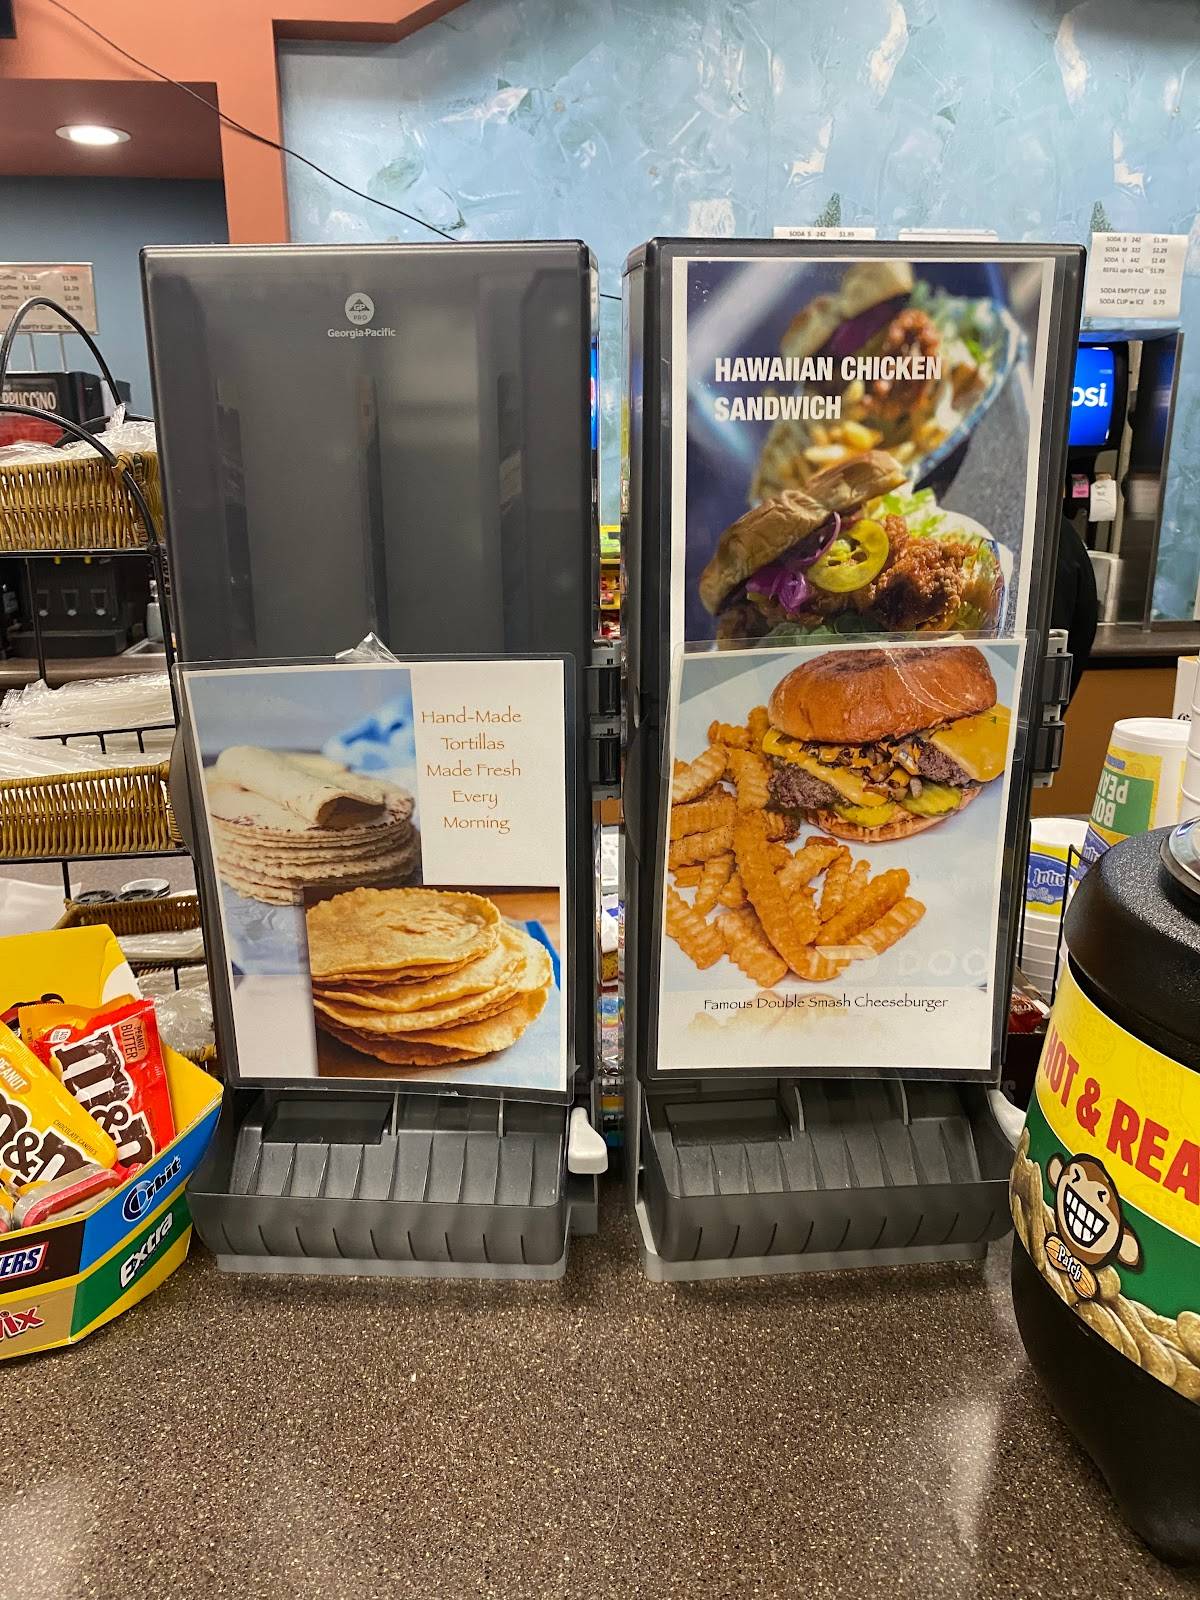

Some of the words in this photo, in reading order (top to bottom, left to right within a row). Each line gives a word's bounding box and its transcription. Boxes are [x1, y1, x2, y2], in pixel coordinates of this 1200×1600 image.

[327, 327, 397, 339] Georgia-Pacific
[714, 356, 833, 382] HAWAIIAN
[841, 355, 942, 381] CHICKEN
[714, 395, 842, 422] SANDWICH
[421, 705, 522, 724] Hand-Made
[440, 732, 505, 751] Tortillas
[427, 759, 473, 777] Made
[477, 759, 521, 777] Fresh
[452, 790, 498, 809] Every
[1097, 770, 1130, 805] PEA
[1091, 793, 1116, 828] BOI
[443, 815, 511, 834] Morning
[703, 999, 753, 1011] Famous
[756, 994, 805, 1010] Double
[808, 993, 851, 1009] Smash
[855, 993, 949, 1012] Cheeseburger
[120, 1023, 138, 1060] BUTTER
[135, 1025, 146, 1052] PEANUT
[1043, 1023, 1080, 1108] HOT
[1075, 1077, 1101, 1137] &
[1106, 1098, 1200, 1206] REA
[122, 1155, 182, 1222] Orbit
[0, 1246, 42, 1277] ERS
[120, 1212, 173, 1288] Extra
[1057, 1244, 1083, 1282] Patch
